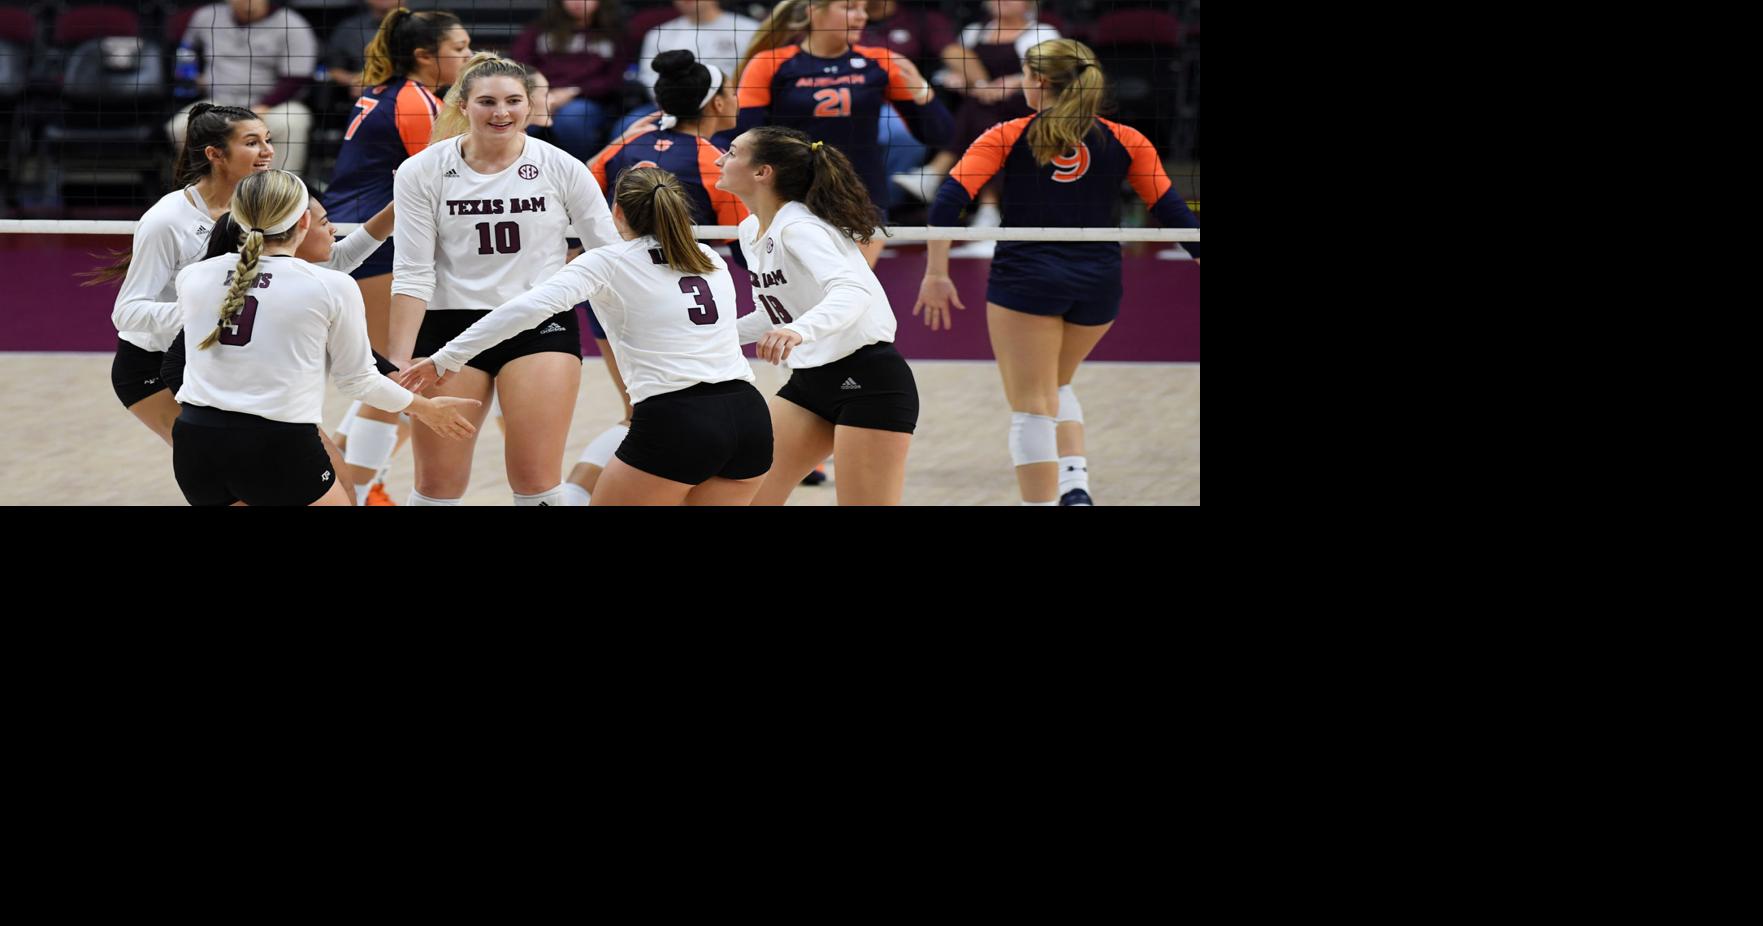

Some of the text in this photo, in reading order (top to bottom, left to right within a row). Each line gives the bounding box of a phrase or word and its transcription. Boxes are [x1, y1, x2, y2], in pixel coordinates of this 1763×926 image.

[344, 96, 379, 140] 7
[813, 87, 851, 117] 21
[519, 164, 538, 180] SEC
[1050, 140, 1091, 182] 9
[446, 198, 504, 215] TEXAS
[475, 221, 521, 255] 10
[678, 275, 719, 325] 3
[218, 295, 258, 347] 9
